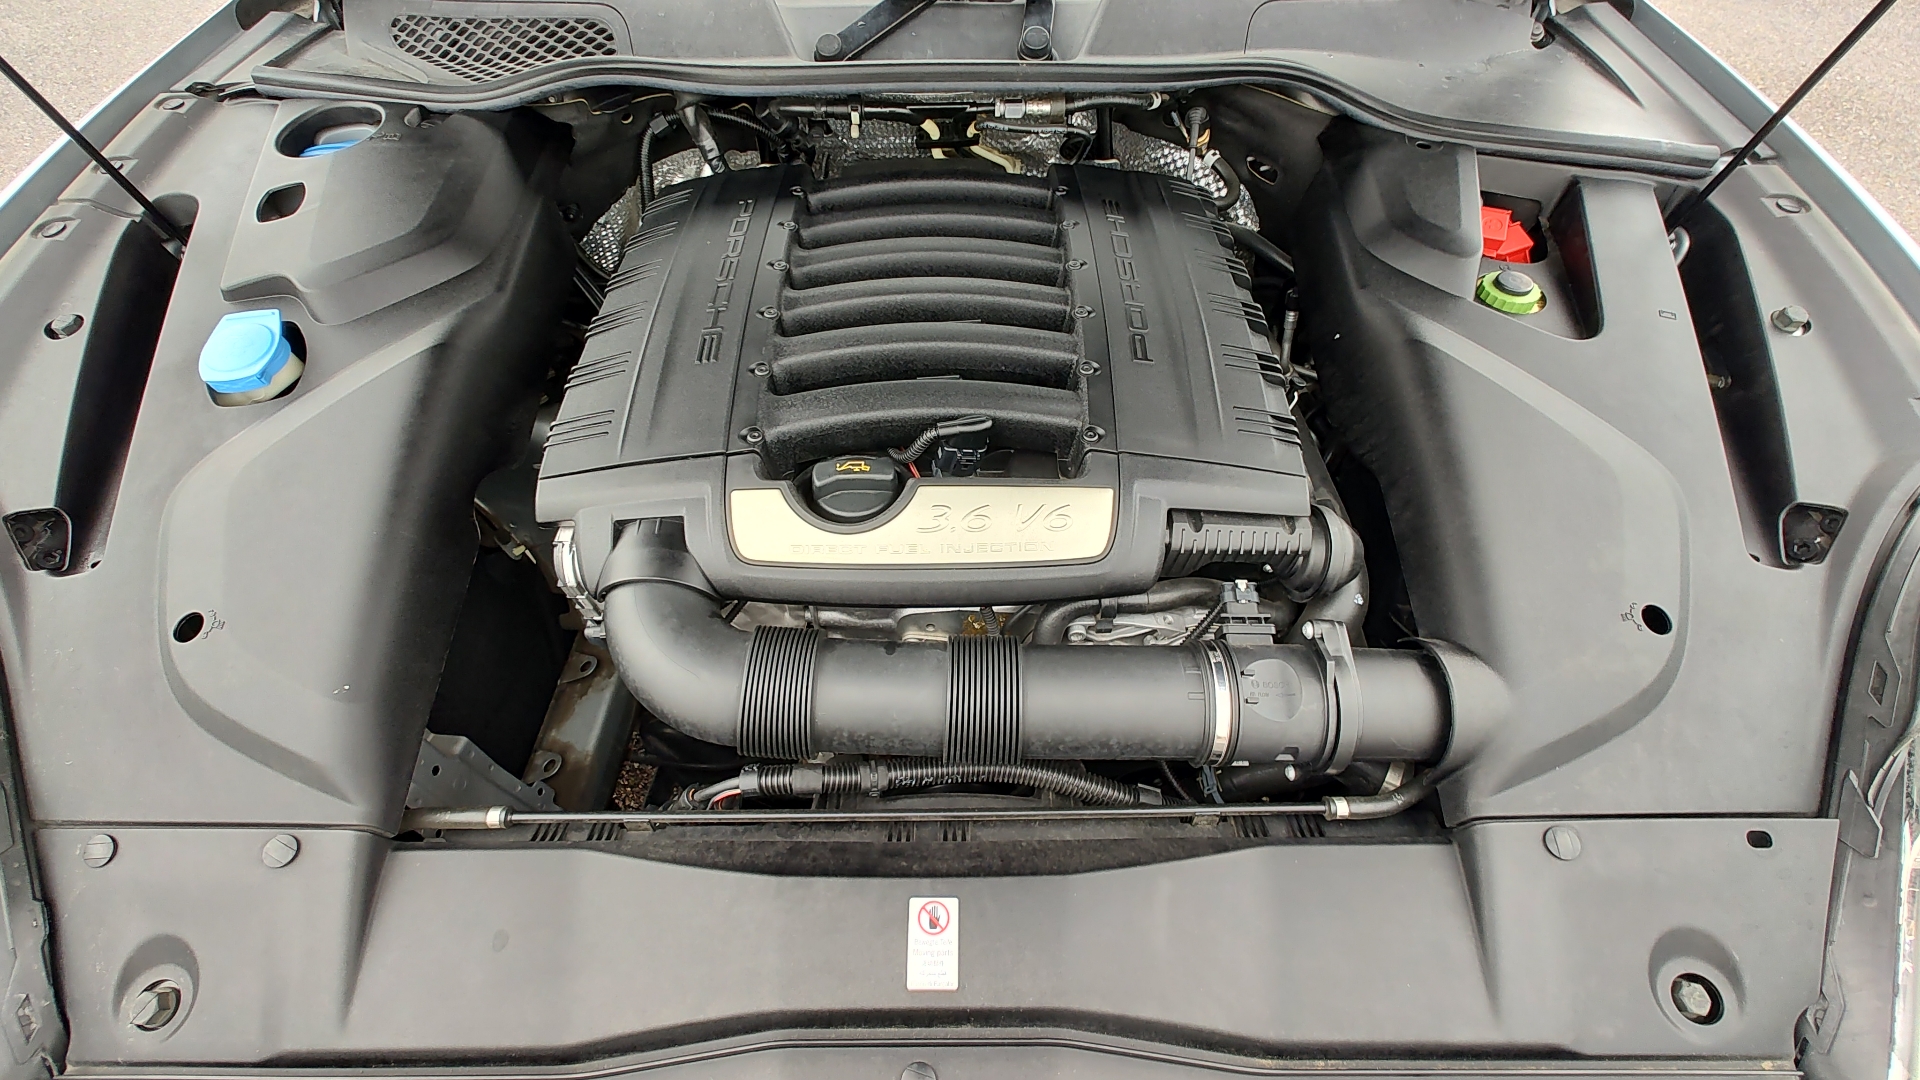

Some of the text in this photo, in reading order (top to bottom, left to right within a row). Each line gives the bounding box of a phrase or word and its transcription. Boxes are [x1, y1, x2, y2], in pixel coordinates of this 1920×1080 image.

[694, 199, 757, 365] PORSCHE
[1102, 199, 1155, 364] PORSCHE
[915, 503, 1075, 534] 3.6 V6
[789, 540, 1056, 555] DIRECT FUEL INJECTION
[936, 948, 954, 957] parts
